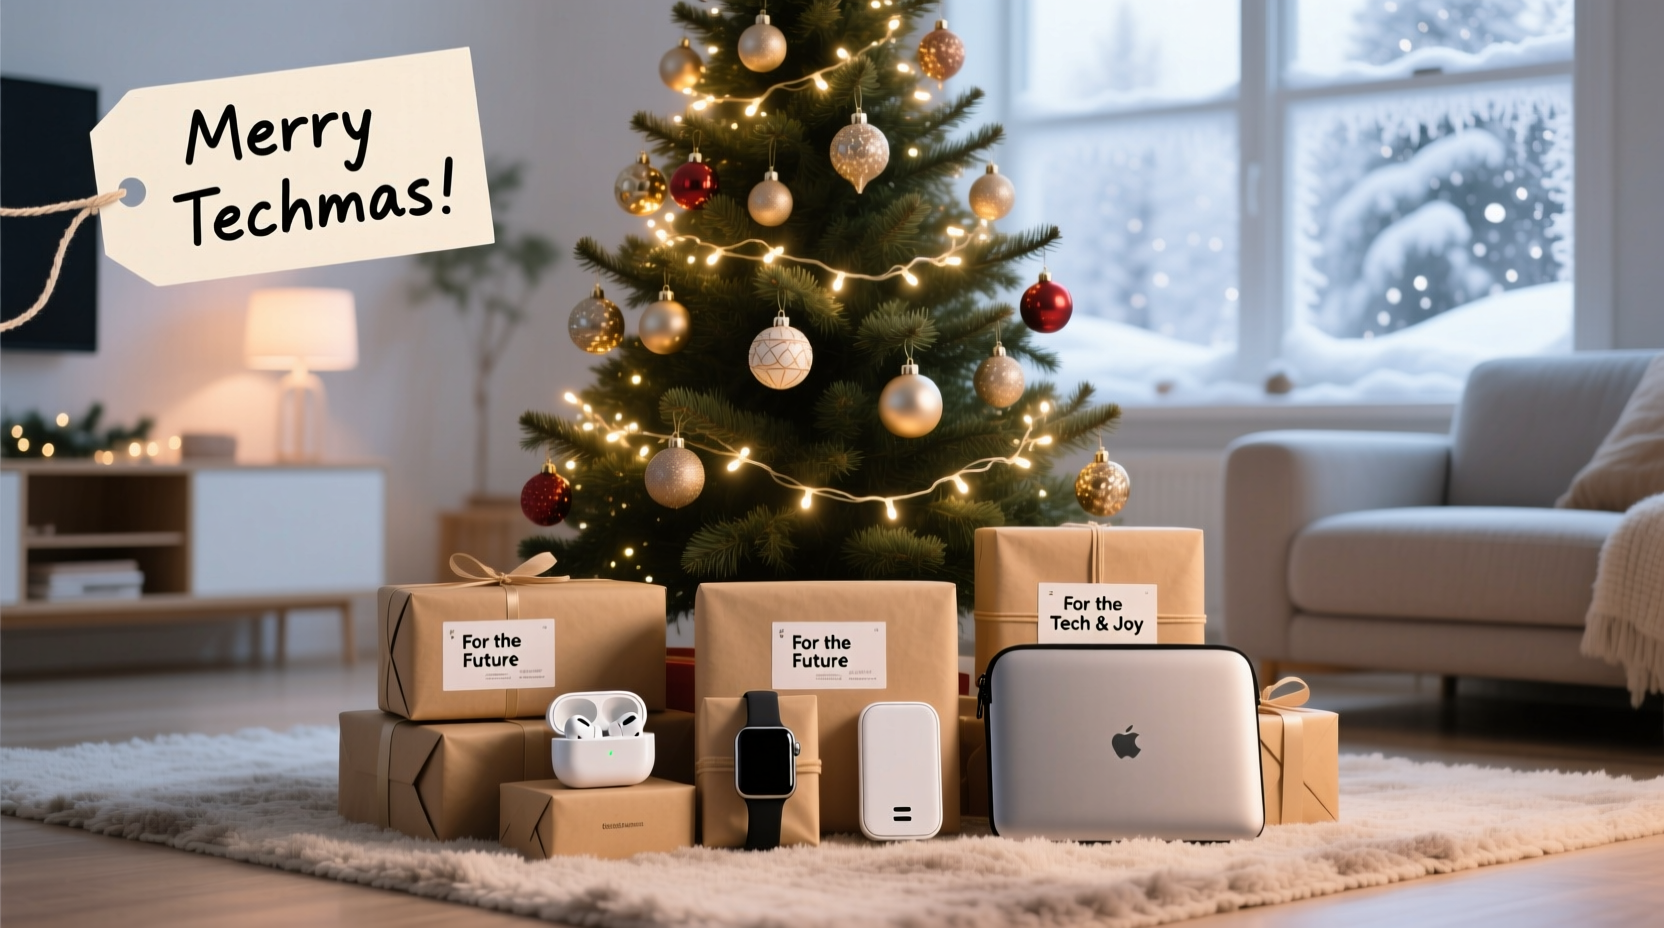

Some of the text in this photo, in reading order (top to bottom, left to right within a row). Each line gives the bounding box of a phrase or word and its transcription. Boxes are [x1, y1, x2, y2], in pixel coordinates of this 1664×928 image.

[186, 104, 372, 172] Merry
[173, 157, 454, 247] Techmas!
[1063, 595, 1123, 611] For the
[1050, 615, 1144, 636] Tech & Joy
[462, 634, 490, 650] For
[493, 632, 522, 648] the
[792, 634, 852, 650] For the
[463, 652, 519, 668] Future
[792, 652, 849, 668] Future
